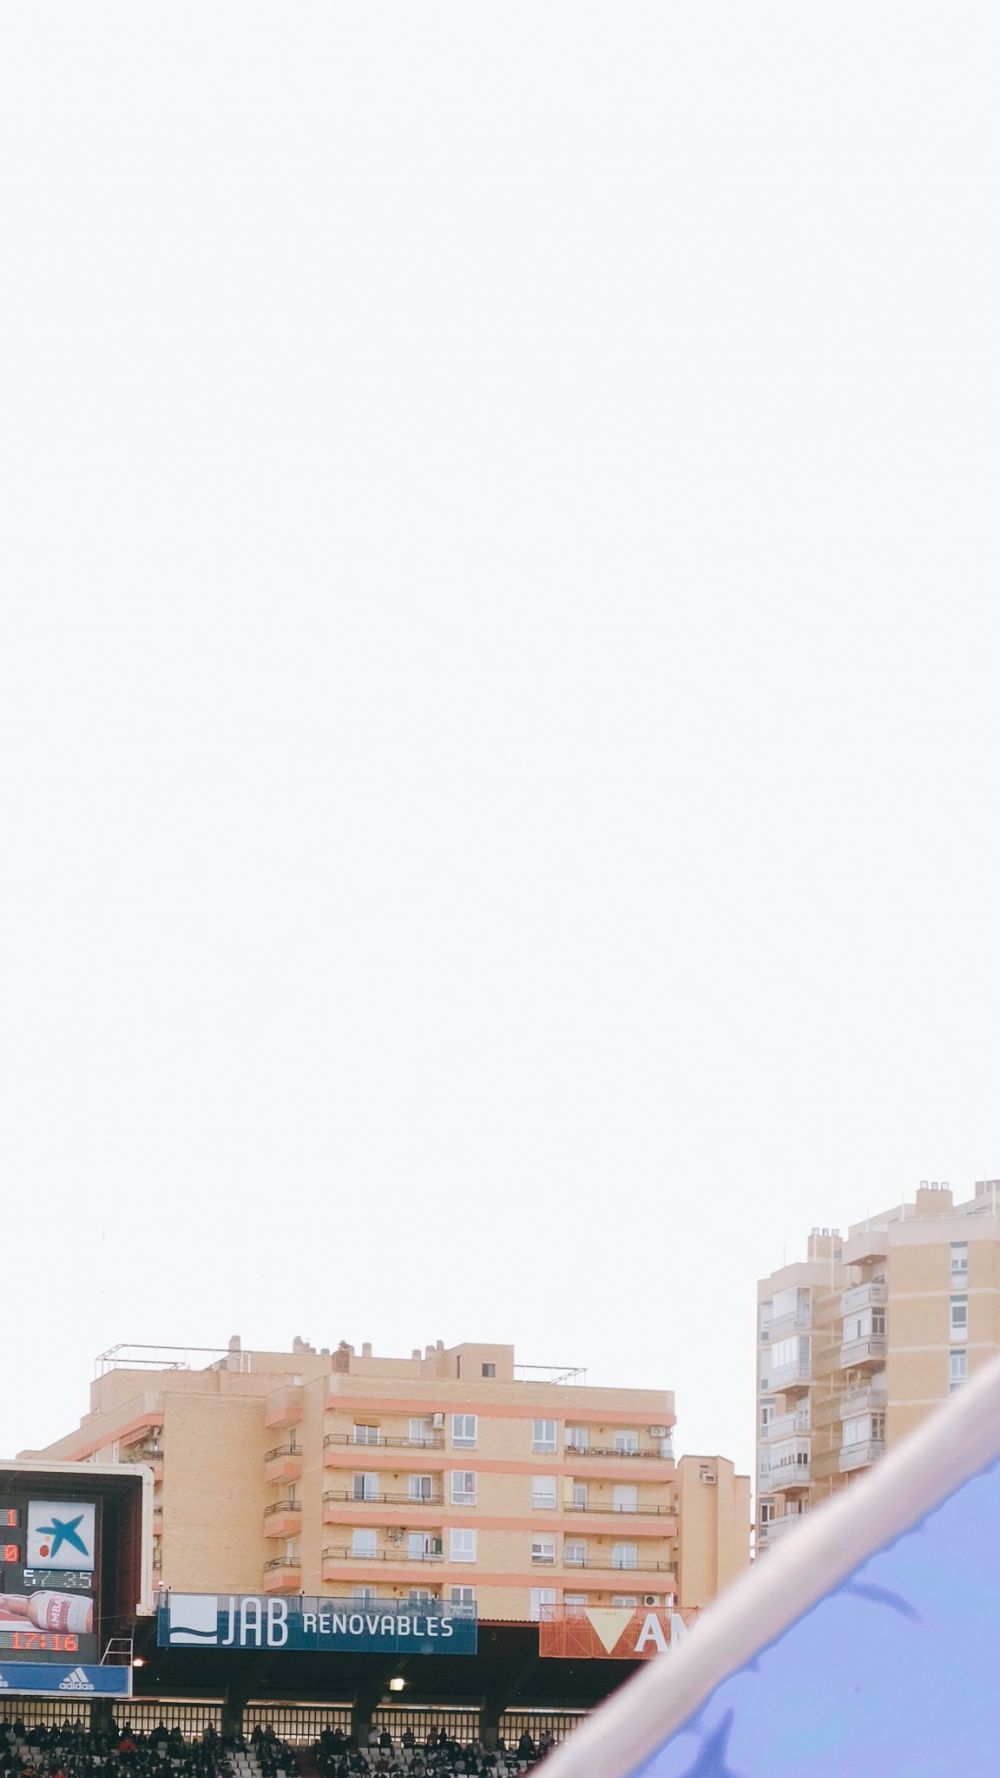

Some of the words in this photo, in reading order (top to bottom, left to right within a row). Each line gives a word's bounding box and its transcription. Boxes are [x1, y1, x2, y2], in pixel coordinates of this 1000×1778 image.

[7, 1509, 17, 1527] 1
[4, 1544, 19, 1562] 0
[221, 1596, 289, 1647] JAB
[302, 1613, 454, 1637] RENOVABLES
[12, 1631, 78, 1651] 17:16
[58, 1681, 95, 1691] adidas
